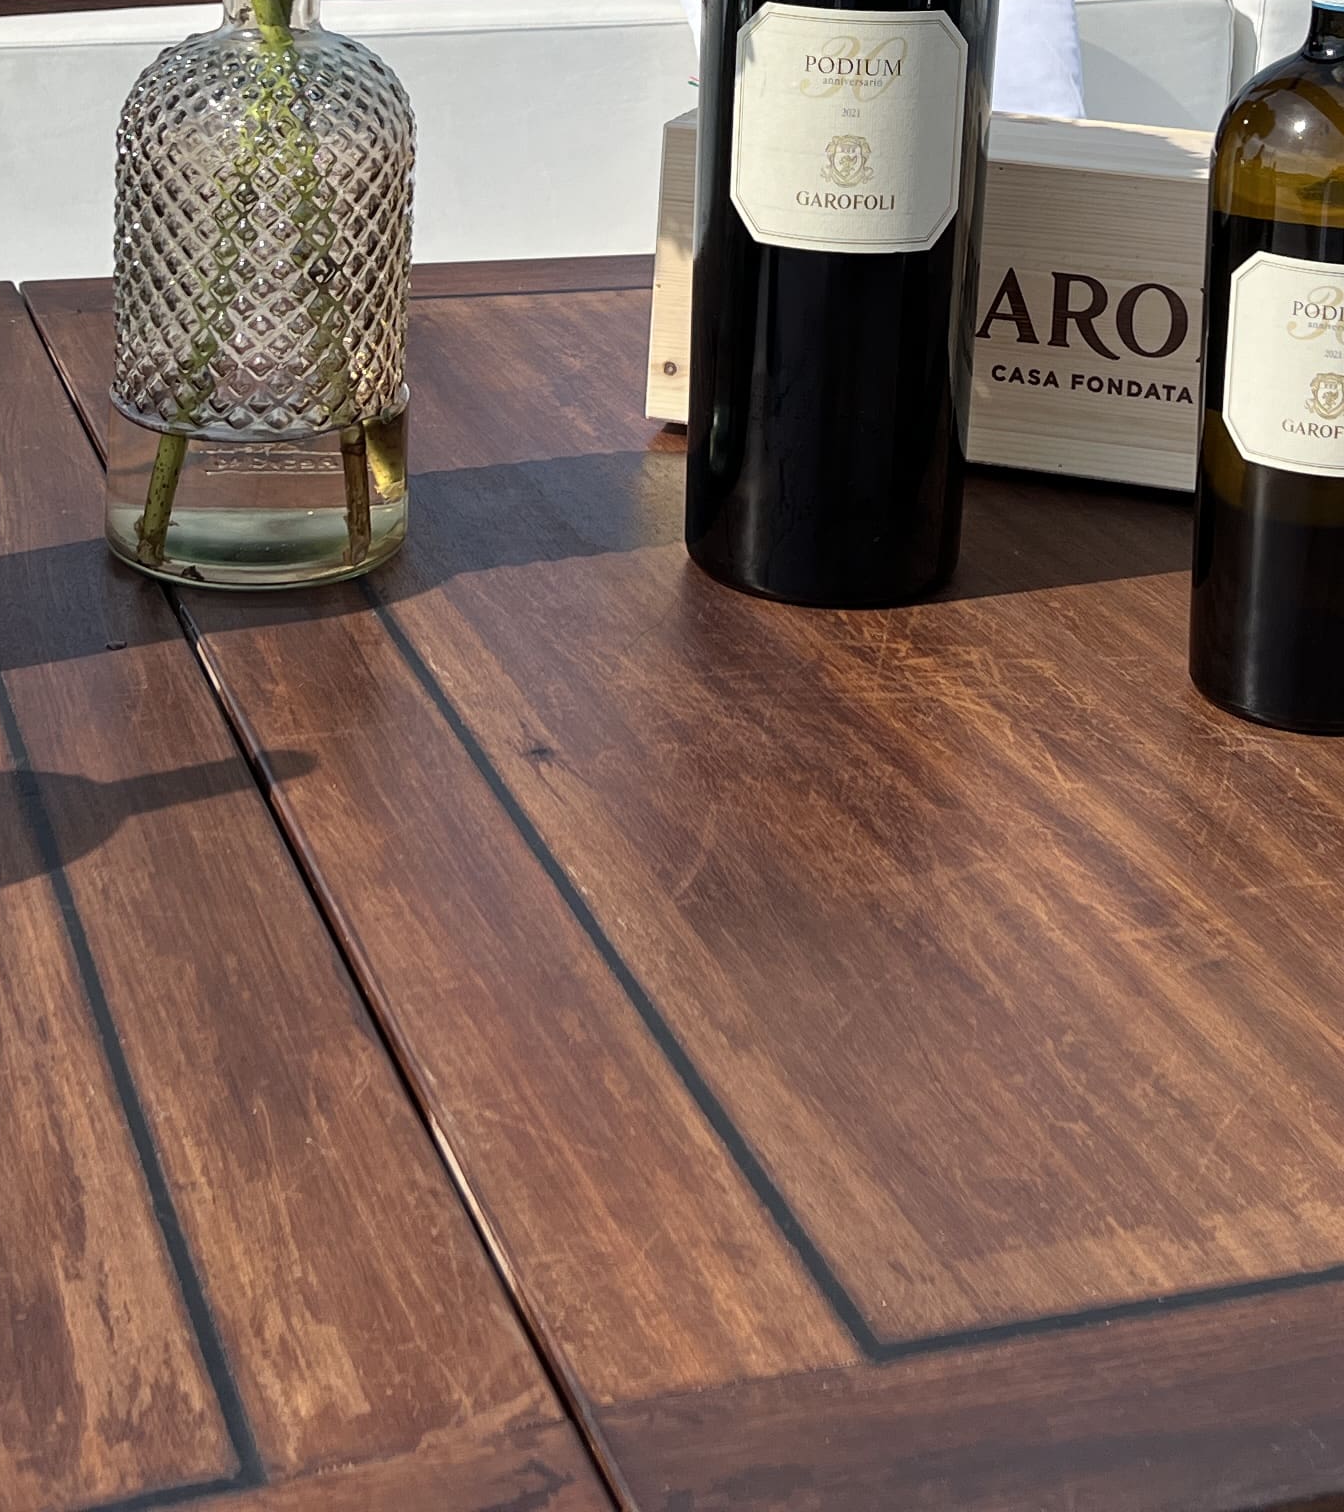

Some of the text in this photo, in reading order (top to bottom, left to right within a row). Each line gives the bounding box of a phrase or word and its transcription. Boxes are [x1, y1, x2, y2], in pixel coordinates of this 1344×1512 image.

[804, 55, 903, 77] PODIUM
[822, 76, 883, 88] anniversario
[841, 108, 861, 118] 2021
[796, 191, 895, 211] GAROFOLI
[976, 267, 1205, 363] ARO
[991, 364, 1193, 404] CASA FONDATA
